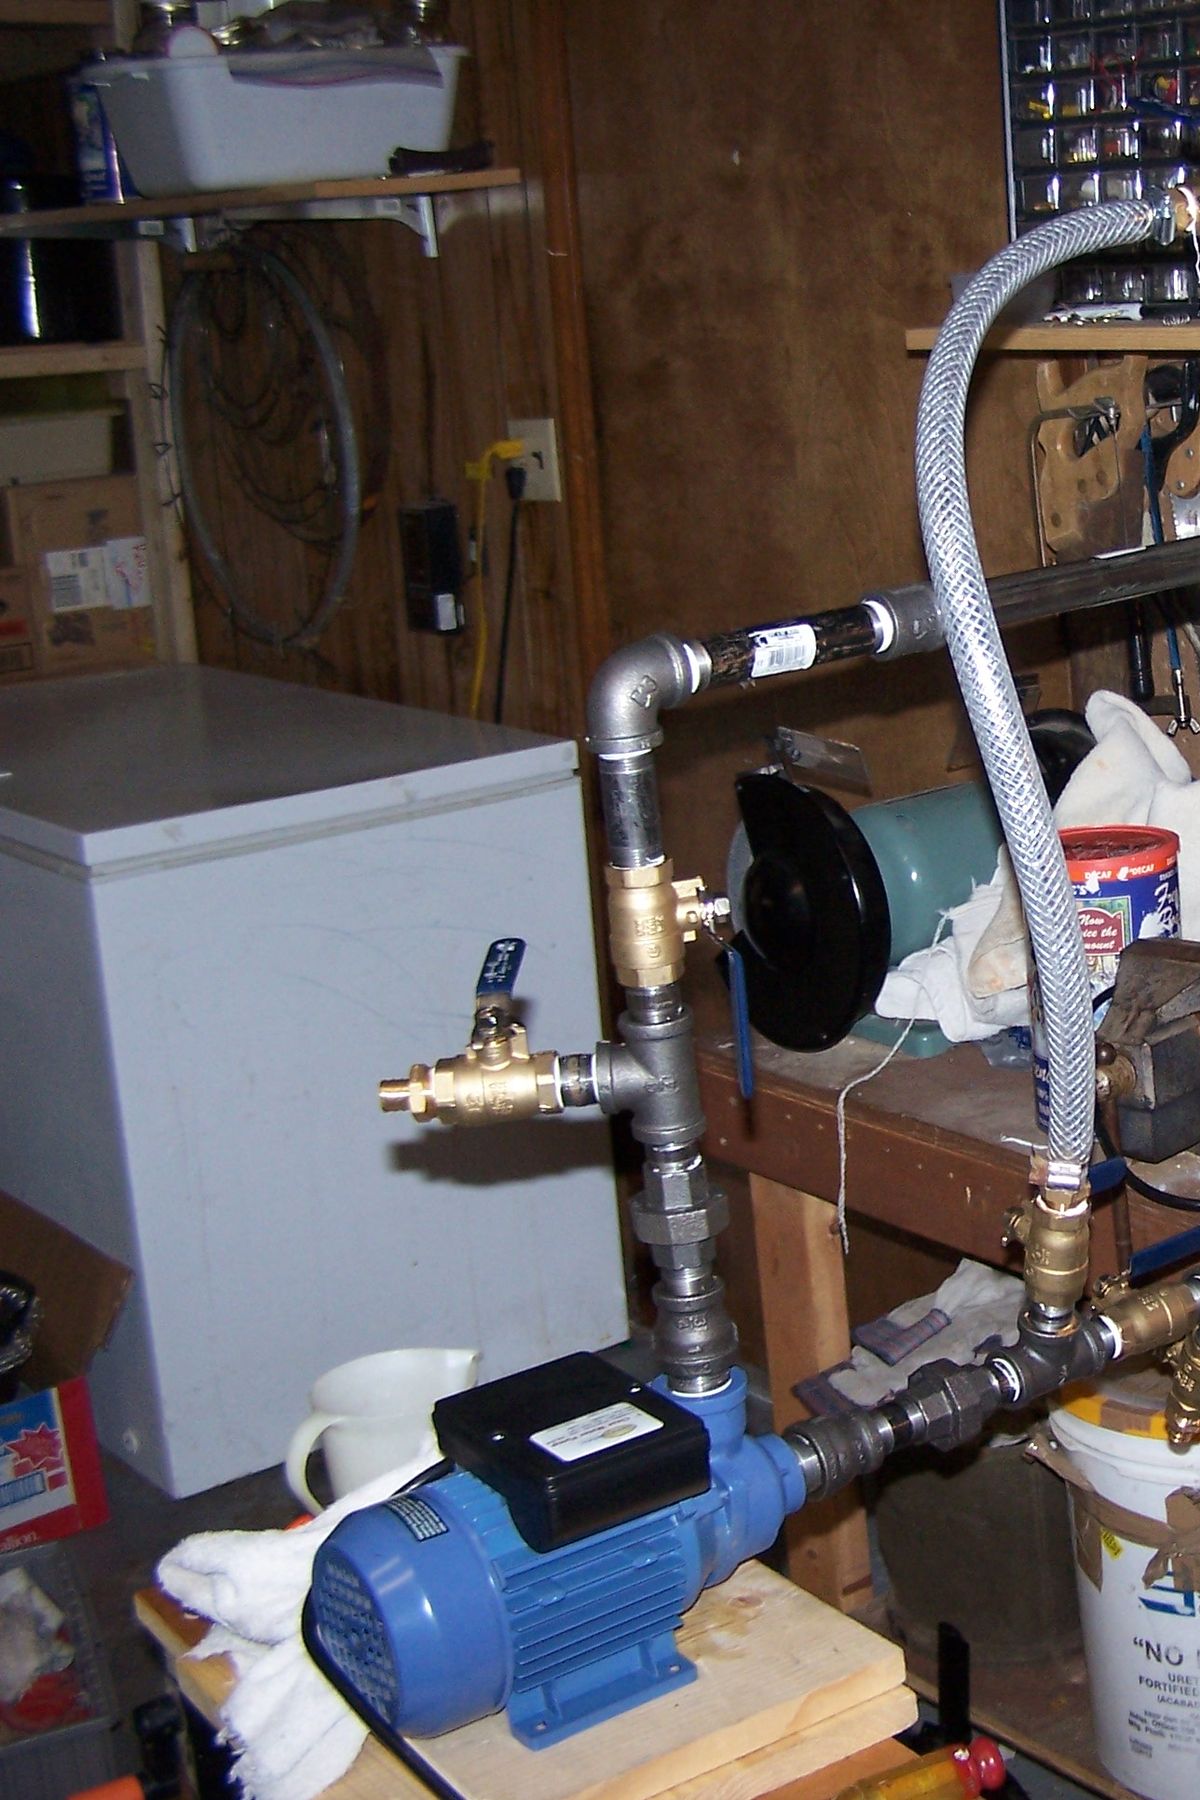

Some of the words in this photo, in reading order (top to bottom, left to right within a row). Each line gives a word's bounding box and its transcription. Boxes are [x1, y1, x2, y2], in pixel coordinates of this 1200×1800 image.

[1078, 914, 1105, 926] Now
[1083, 928, 1098, 938] ice
[1100, 926, 1118, 938] the
[1084, 940, 1116, 950] mount
